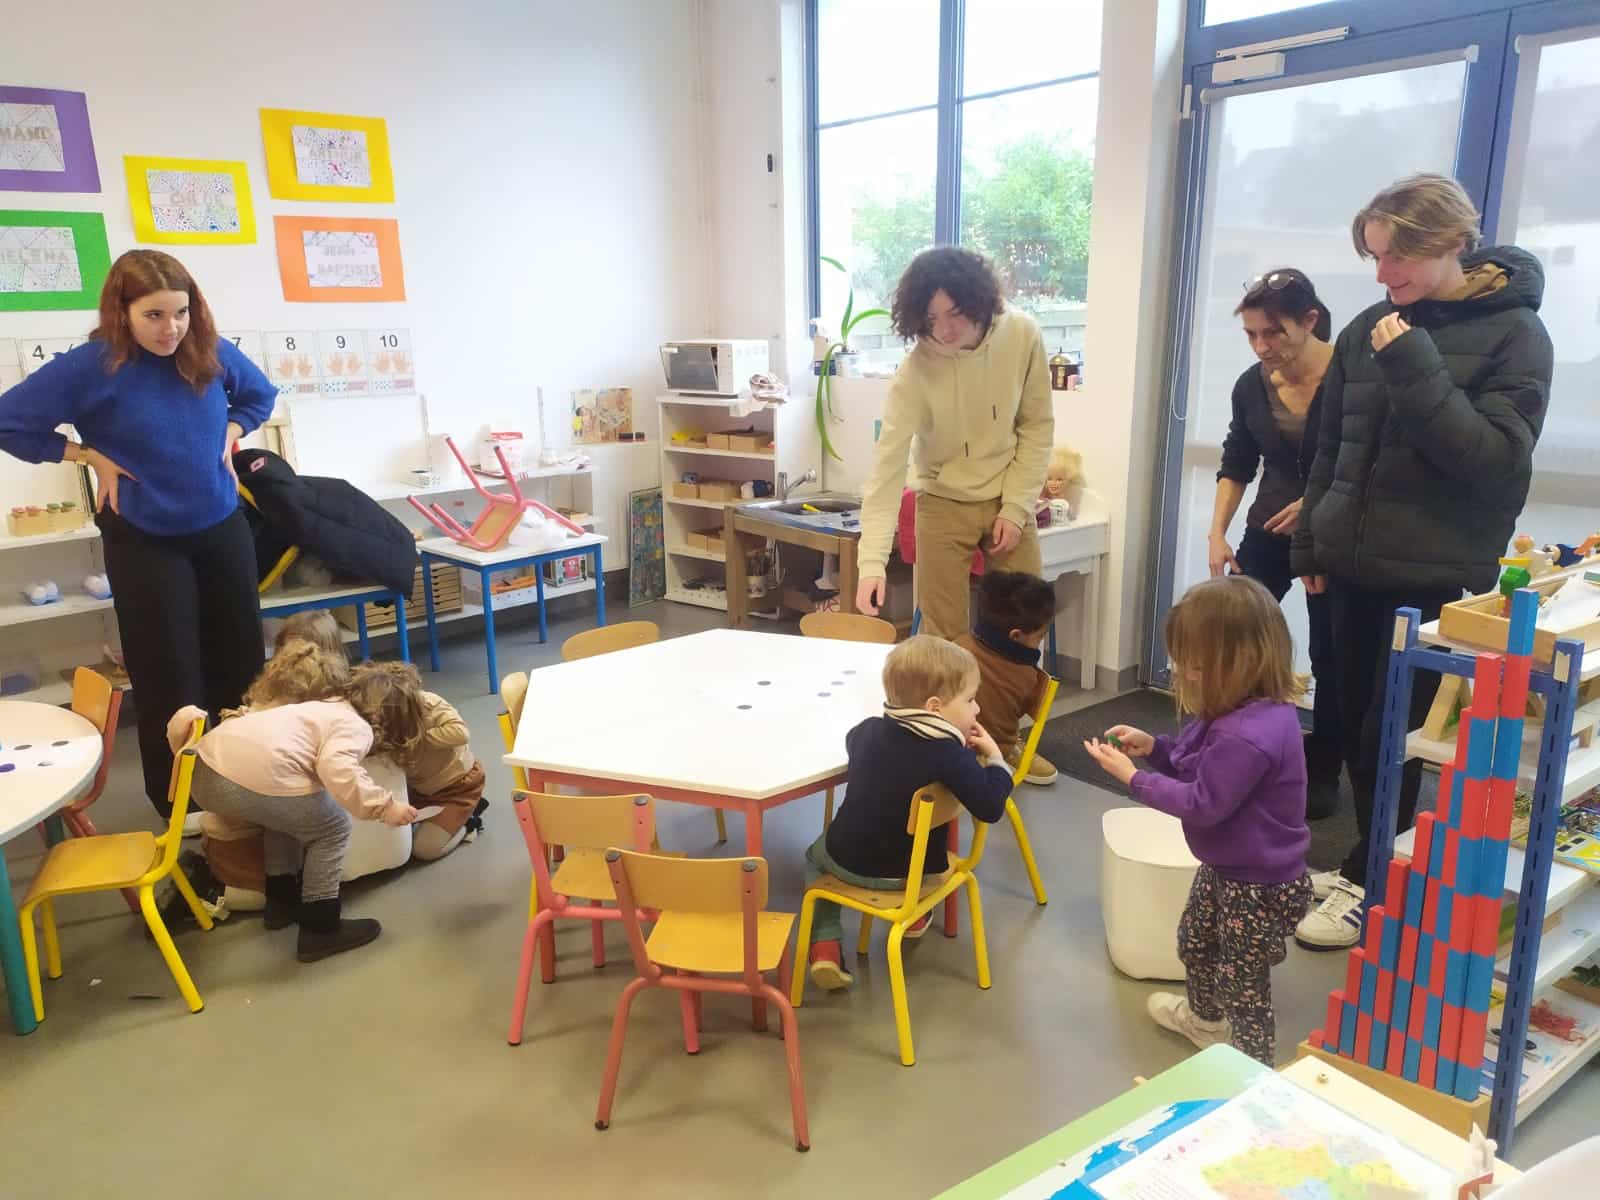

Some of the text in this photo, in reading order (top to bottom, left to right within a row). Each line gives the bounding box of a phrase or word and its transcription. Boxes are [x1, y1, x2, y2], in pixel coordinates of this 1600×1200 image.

[231, 336, 242, 349] 7
[285, 336, 296, 351] 8
[335, 335, 346, 349] 9
[379, 334, 398, 348] 10
[32, 344, 45, 360] 4
